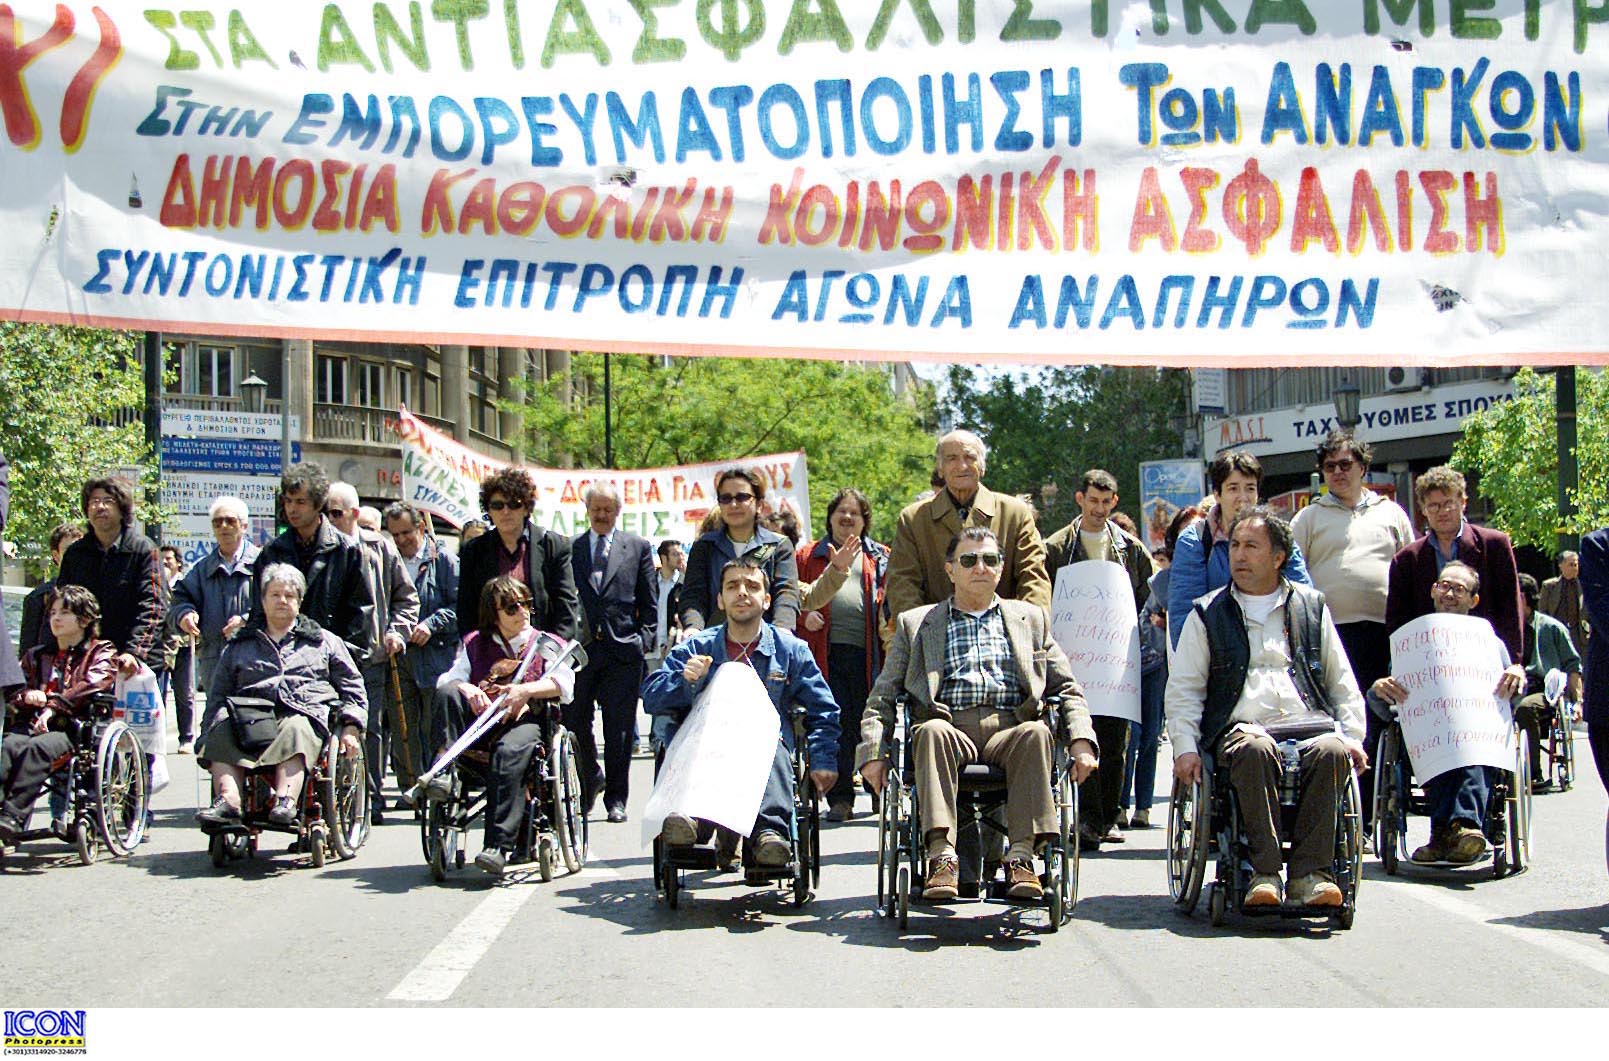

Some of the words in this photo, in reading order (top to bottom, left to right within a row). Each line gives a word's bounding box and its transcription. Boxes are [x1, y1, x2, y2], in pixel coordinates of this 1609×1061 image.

[143, 9, 278, 70] ΣΤΑ
[136, 85, 273, 138] ΣΤΗΝ
[282, 67, 1082, 167] ΕΜΠΟΡΕΥΜΑΤΟΠΟΙΗΣΗ
[1261, 57, 1585, 153] ΑΝΑΓΚΩΝ
[159, 153, 402, 233] ΔΗΜΟΣΙΑ
[421, 168, 734, 244] ΚΑΘΟΛΙΚΗ
[758, 155, 1098, 254] ΚΟΙΝΩΝΙΚΗ
[1128, 157, 1504, 257] ΑΣΦΑΛΙΣΗ
[83, 248, 427, 306] ΣΥΝΤΟΝΙΣΤΙΚΗ
[454, 259, 744, 319] ΕΠΙΤΡΟΠΗ
[771, 270, 972, 329] ΑΓΩΝΑ
[1008, 274, 1379, 330] ΑΝΑΠΗΡΩΝ
[532, 508, 670, 538] ΣΛΗΕΙΣ
[560, 477, 663, 504] ΔΟΕΙΑ
